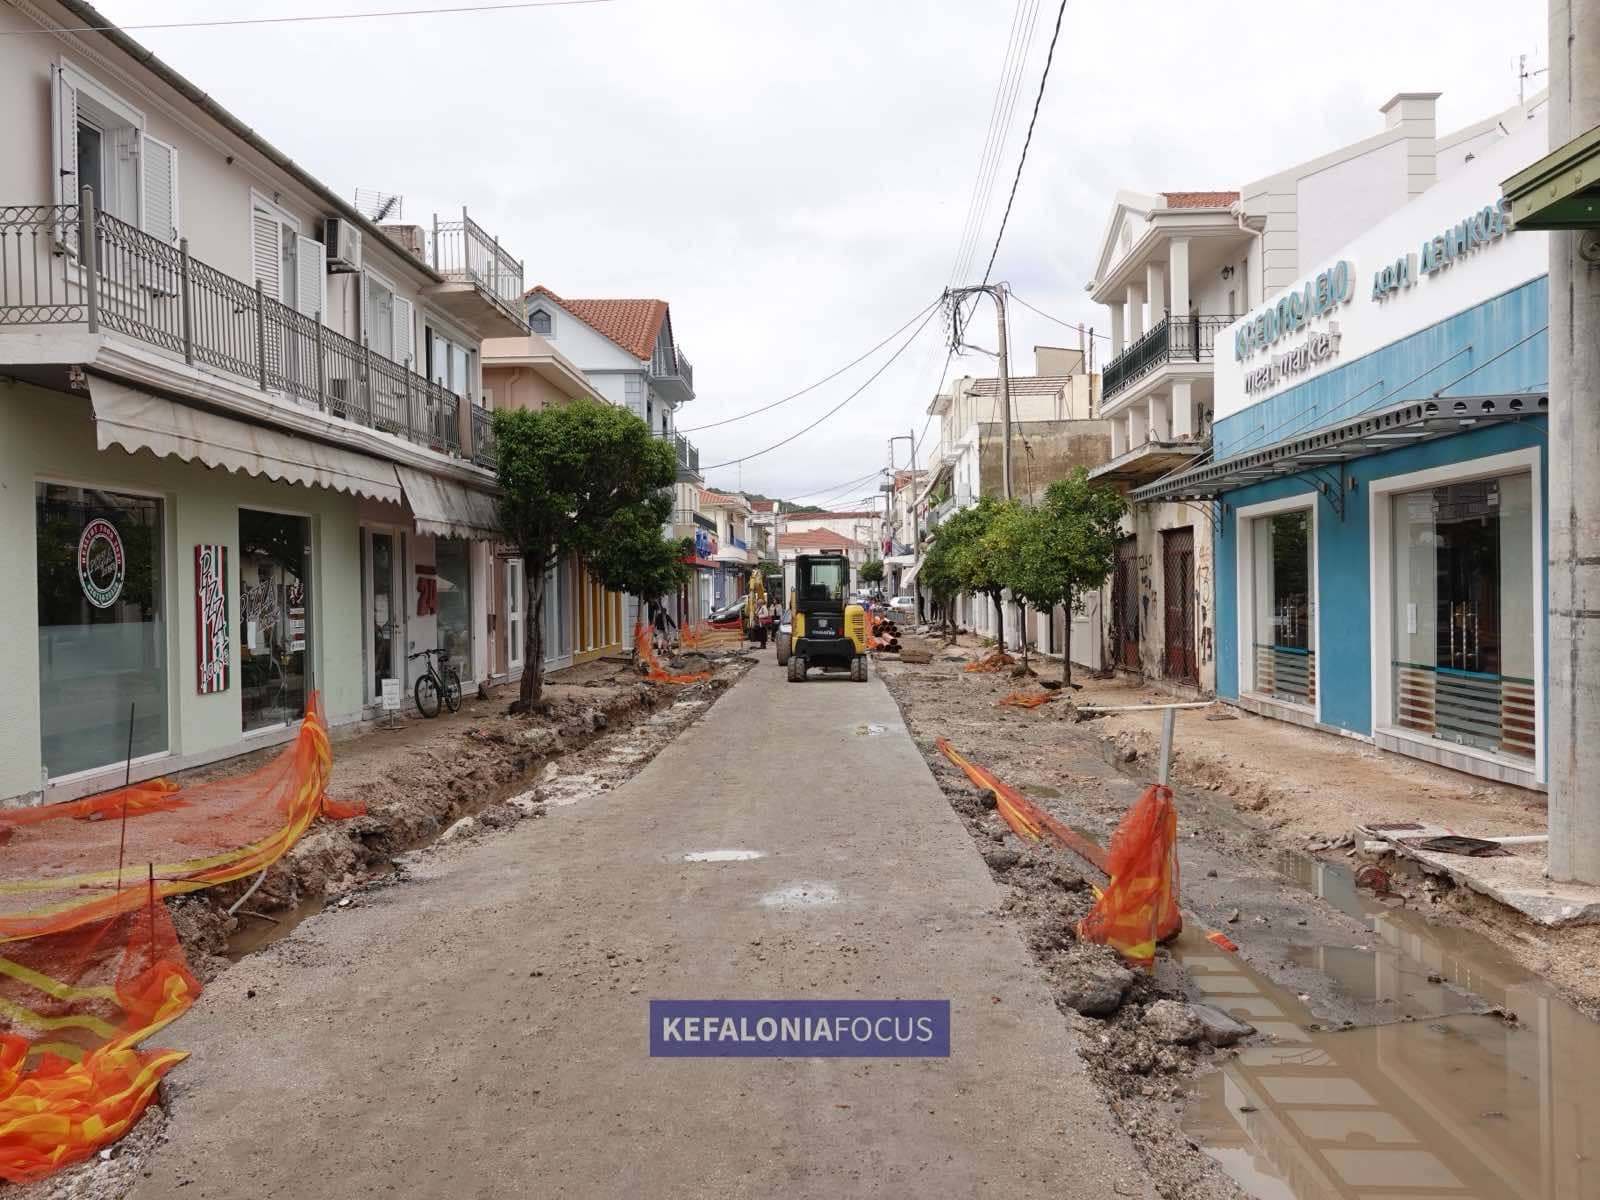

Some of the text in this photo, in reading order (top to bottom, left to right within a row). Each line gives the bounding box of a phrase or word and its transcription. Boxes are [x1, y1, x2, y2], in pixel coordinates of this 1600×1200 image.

[1235, 260, 1354, 361] ΚΡΕΟΠΩΛΕΙΟ
[1245, 321, 1342, 391] meat market
